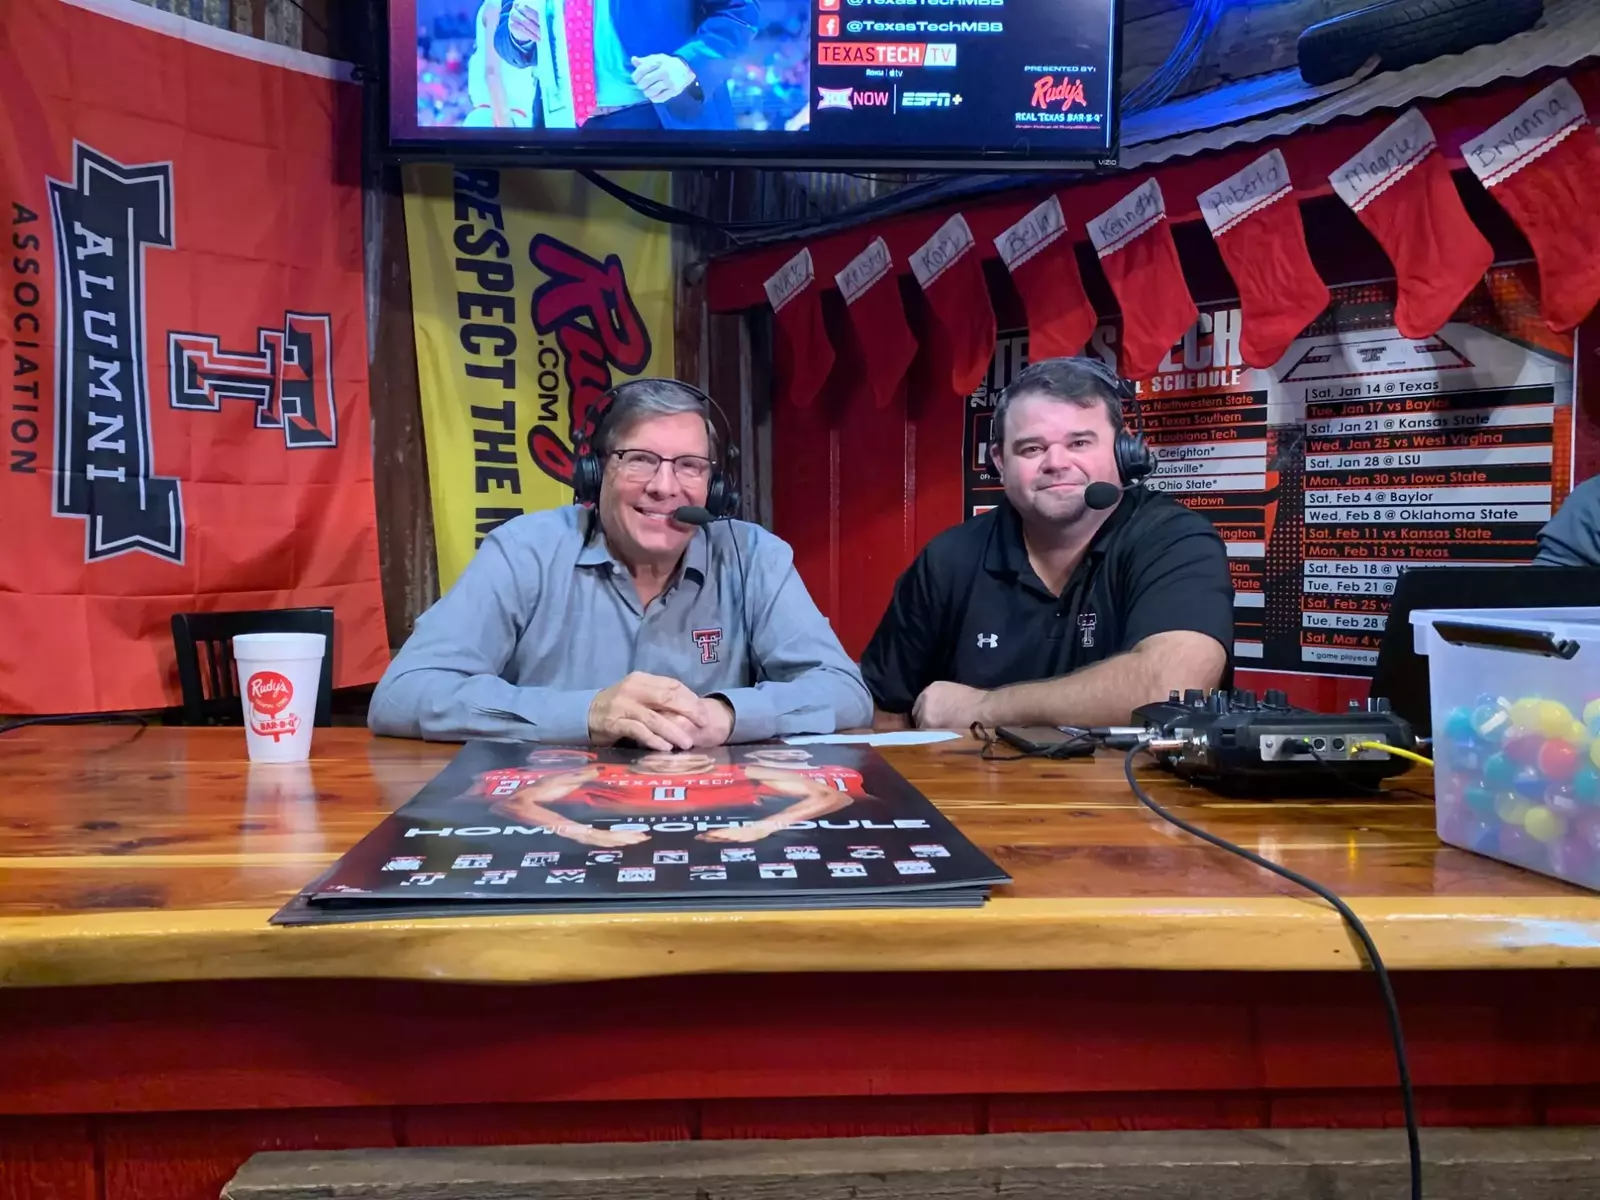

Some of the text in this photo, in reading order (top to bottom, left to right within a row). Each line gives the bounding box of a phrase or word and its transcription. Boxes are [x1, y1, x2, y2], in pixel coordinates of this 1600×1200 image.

[846, 20, 1004, 33] @TexasTechMBB
[931, 47, 952, 63] TV
[854, 91, 889, 106] NOW
[1030, 75, 1087, 111] Rudy's
[1015, 112, 1037, 122] REAL
[1037, 112, 1065, 122] TEXAS
[1470, 98, 1567, 168] Bryanna
[1345, 138, 1416, 192] Maggie
[1006, 211, 1052, 251] Bella
[453, 168, 517, 389] RESPECT
[10, 202, 41, 475] ASSOCIATION
[73, 220, 127, 484] ALUMNI
[994, 325, 1117, 390] TES
[537, 339, 560, 422] .COM
[1152, 369, 1241, 392] SCHEDULE
[1312, 381, 1439, 399] Sat, Jan 14 @ Texas
[1153, 397, 1222, 412] Northwestern
[1225, 394, 1254, 406] State
[1341, 404, 1364, 415] Jan
[1368, 401, 1383, 413] 17
[1387, 402, 1401, 411] vs
[1148, 418, 1159, 427] vs
[1161, 415, 1192, 427] Texas
[1194, 412, 1242, 425] Southern
[1311, 414, 1490, 434] Sat, Jan 21 @ Kansas State
[1158, 431, 1208, 443] Louisiana
[1210, 428, 1238, 439] Tech
[1310, 439, 1342, 452] Wed,
[1346, 438, 1371, 450] Jan
[1374, 436, 1390, 448] 25
[1393, 439, 1408, 448] vs
[1412, 434, 1446, 447] West
[470, 401, 522, 495] THE
[1337, 456, 1360, 467] Jan
[1365, 456, 1380, 467] 28
[1383, 455, 1395, 466] @
[1398, 454, 1421, 466] LSU
[1158, 480, 1183, 490] Ohio
[1310, 471, 1487, 487] Mon, Jan 30 vs Iowa State
[1173, 495, 1224, 507] rgetown
[1337, 492, 1361, 503] Feb
[1363, 492, 1372, 503] 4
[1375, 492, 1387, 503] @
[1390, 491, 1433, 505] Baylor
[1309, 508, 1519, 523] Wed, Feb 8 @ Oklahoma State
[1336, 527, 1360, 539] Feb
[1365, 528, 1378, 539] 11
[1383, 530, 1397, 539] vs
[1400, 528, 1450, 539] Kansas
[1454, 527, 1492, 539] State
[1309, 545, 1450, 558] Mon, Feb 13 vs Texas
[1308, 563, 1331, 575] Sat,
[1335, 563, 1359, 574] Feb
[1363, 563, 1378, 574] 18
[1381, 564, 1393, 575] @
[1232, 578, 1260, 589] State
[1307, 580, 1394, 593] Tue, Feb 21 @
[1334, 598, 1357, 610] Feb
[1361, 599, 1376, 611] 25
[1307, 615, 1332, 628] Tue,
[1336, 616, 1359, 628] Feb
[1362, 618, 1378, 629] 28
[1332, 634, 1360, 645] Mar
[1361, 635, 1369, 646] 4
[1316, 653, 1338, 661] game
[1341, 652, 1368, 662] played
[251, 678, 289, 698] Rudy's
[404, 823, 593, 838] HOM
